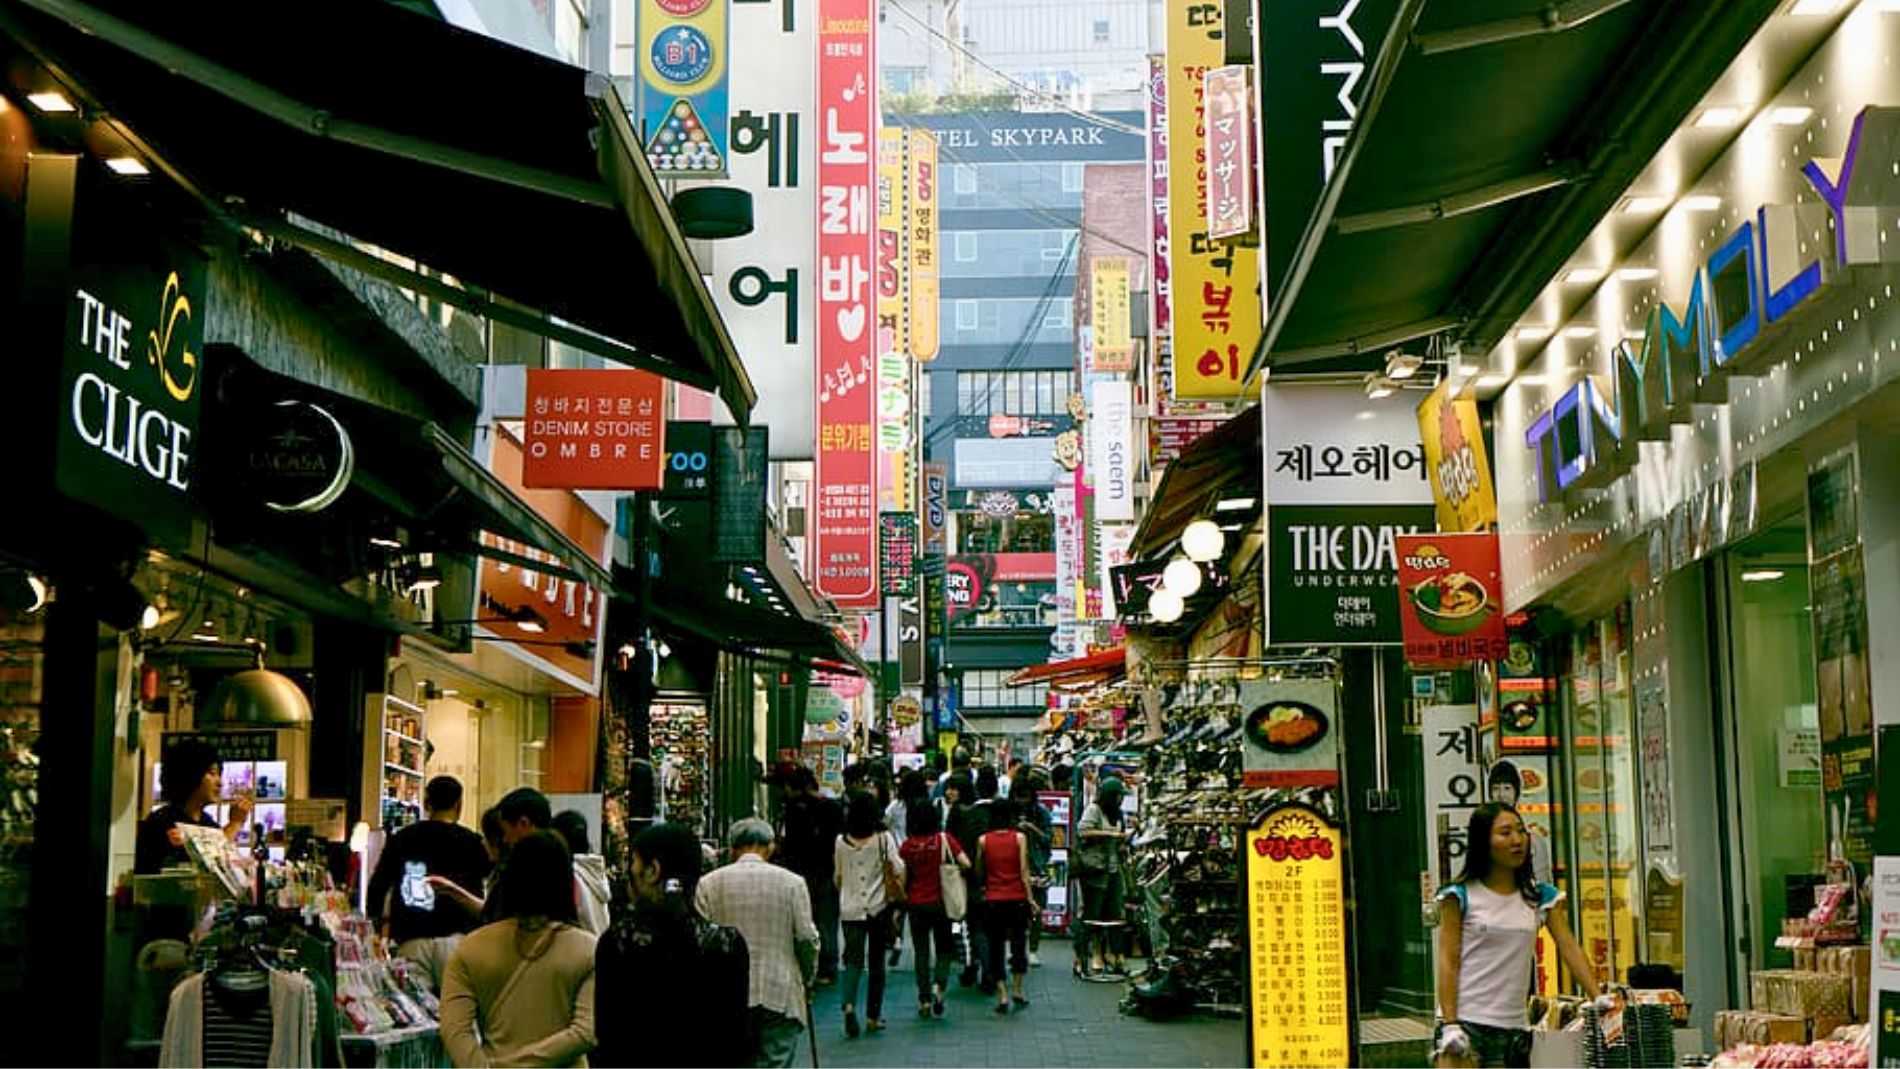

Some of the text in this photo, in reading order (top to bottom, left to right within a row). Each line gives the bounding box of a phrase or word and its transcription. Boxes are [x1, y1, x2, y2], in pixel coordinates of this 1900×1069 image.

[666, 43, 697, 65] B1
[991, 127, 1104, 146] SKYPARK
[729, 0, 799, 343] 헤어
[1214, 117, 1239, 221] マッサージ
[821, 107, 868, 342] 노래방
[76, 288, 132, 370] THE
[1526, 105, 1866, 502] TONYMOLY
[72, 372, 191, 491] CLIGE
[531, 441, 652, 459] OMBRE
[533, 420, 652, 437] DENIM STORE
[1107, 402, 1125, 500] the saem
[1275, 443, 1427, 481] 제오헤어
[1287, 525, 1419, 571] THE DA
[1285, 866, 1303, 877] 2F
